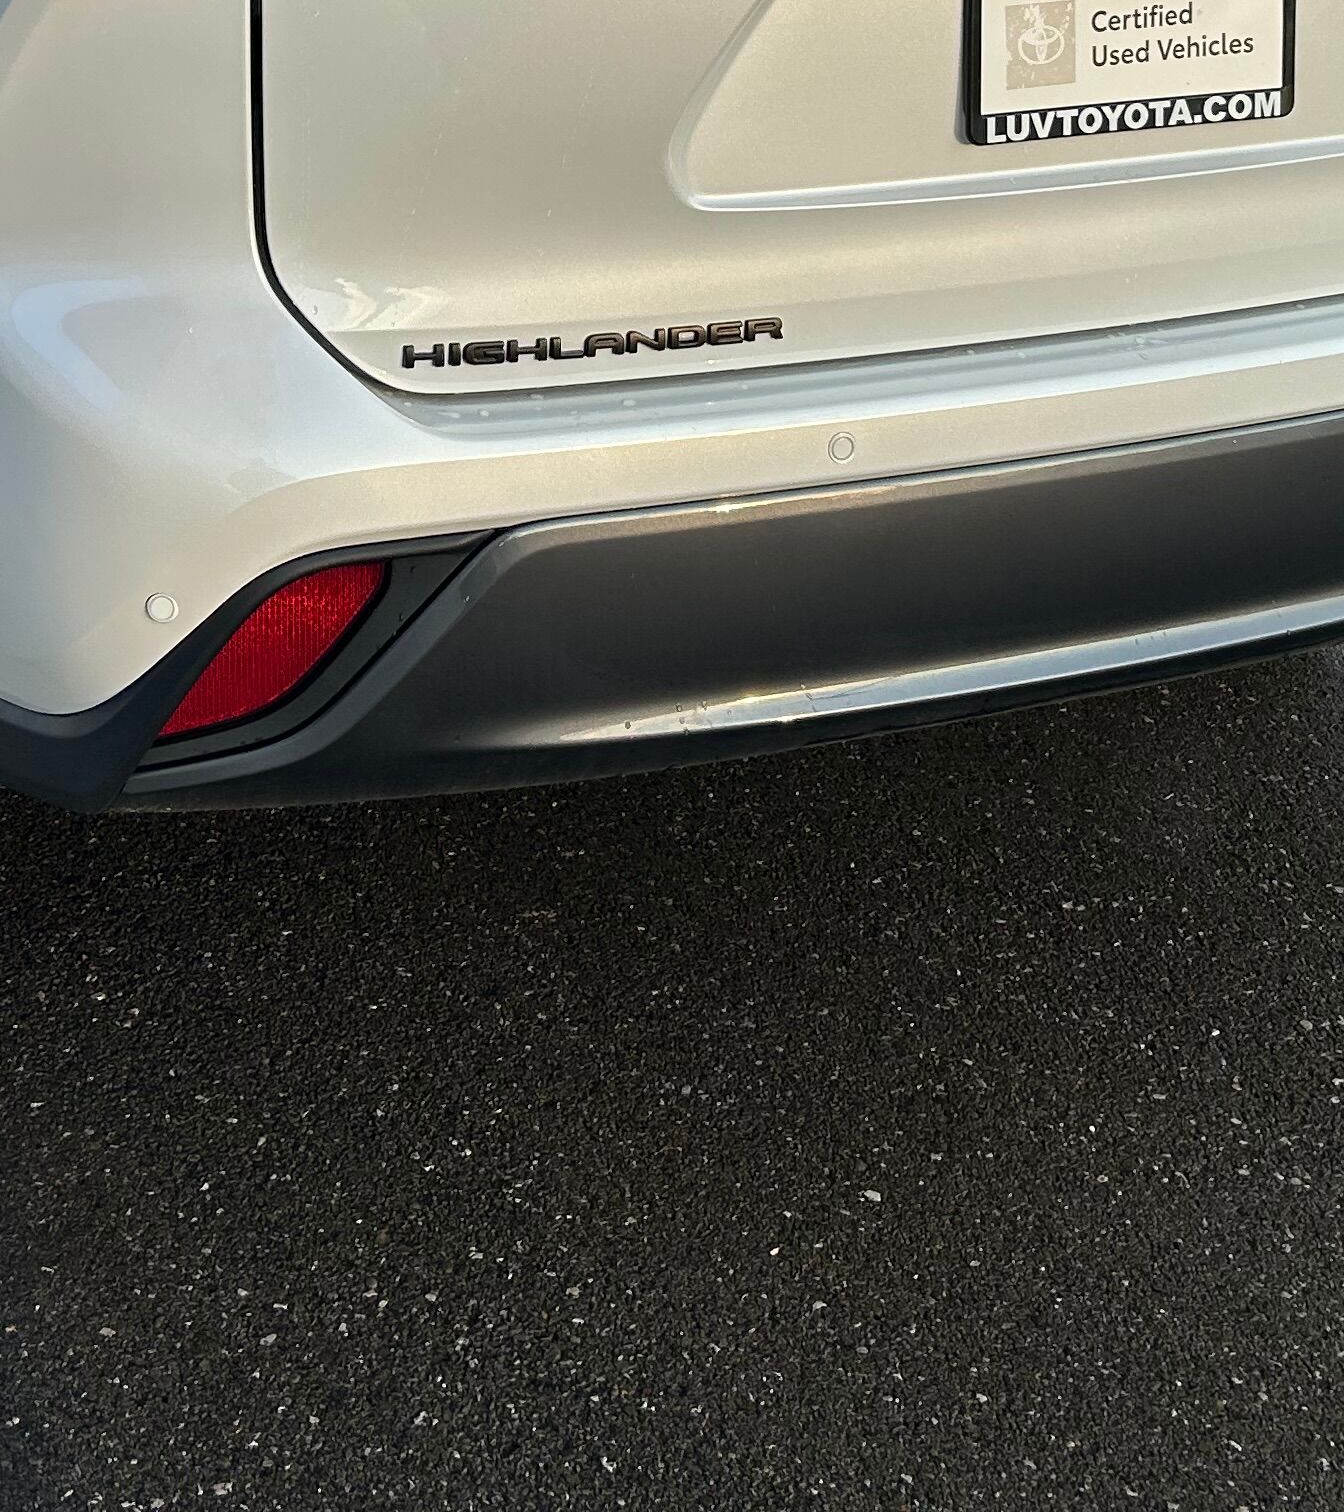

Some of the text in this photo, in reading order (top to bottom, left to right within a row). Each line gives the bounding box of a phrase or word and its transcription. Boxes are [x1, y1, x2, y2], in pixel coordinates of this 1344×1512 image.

[1091, 1, 1193, 33] Certified
[1091, 33, 1255, 68] Used Vehicles
[986, 91, 1282, 144] LUVTOYOTA.COM
[402, 317, 784, 368] HIGHLANDER
